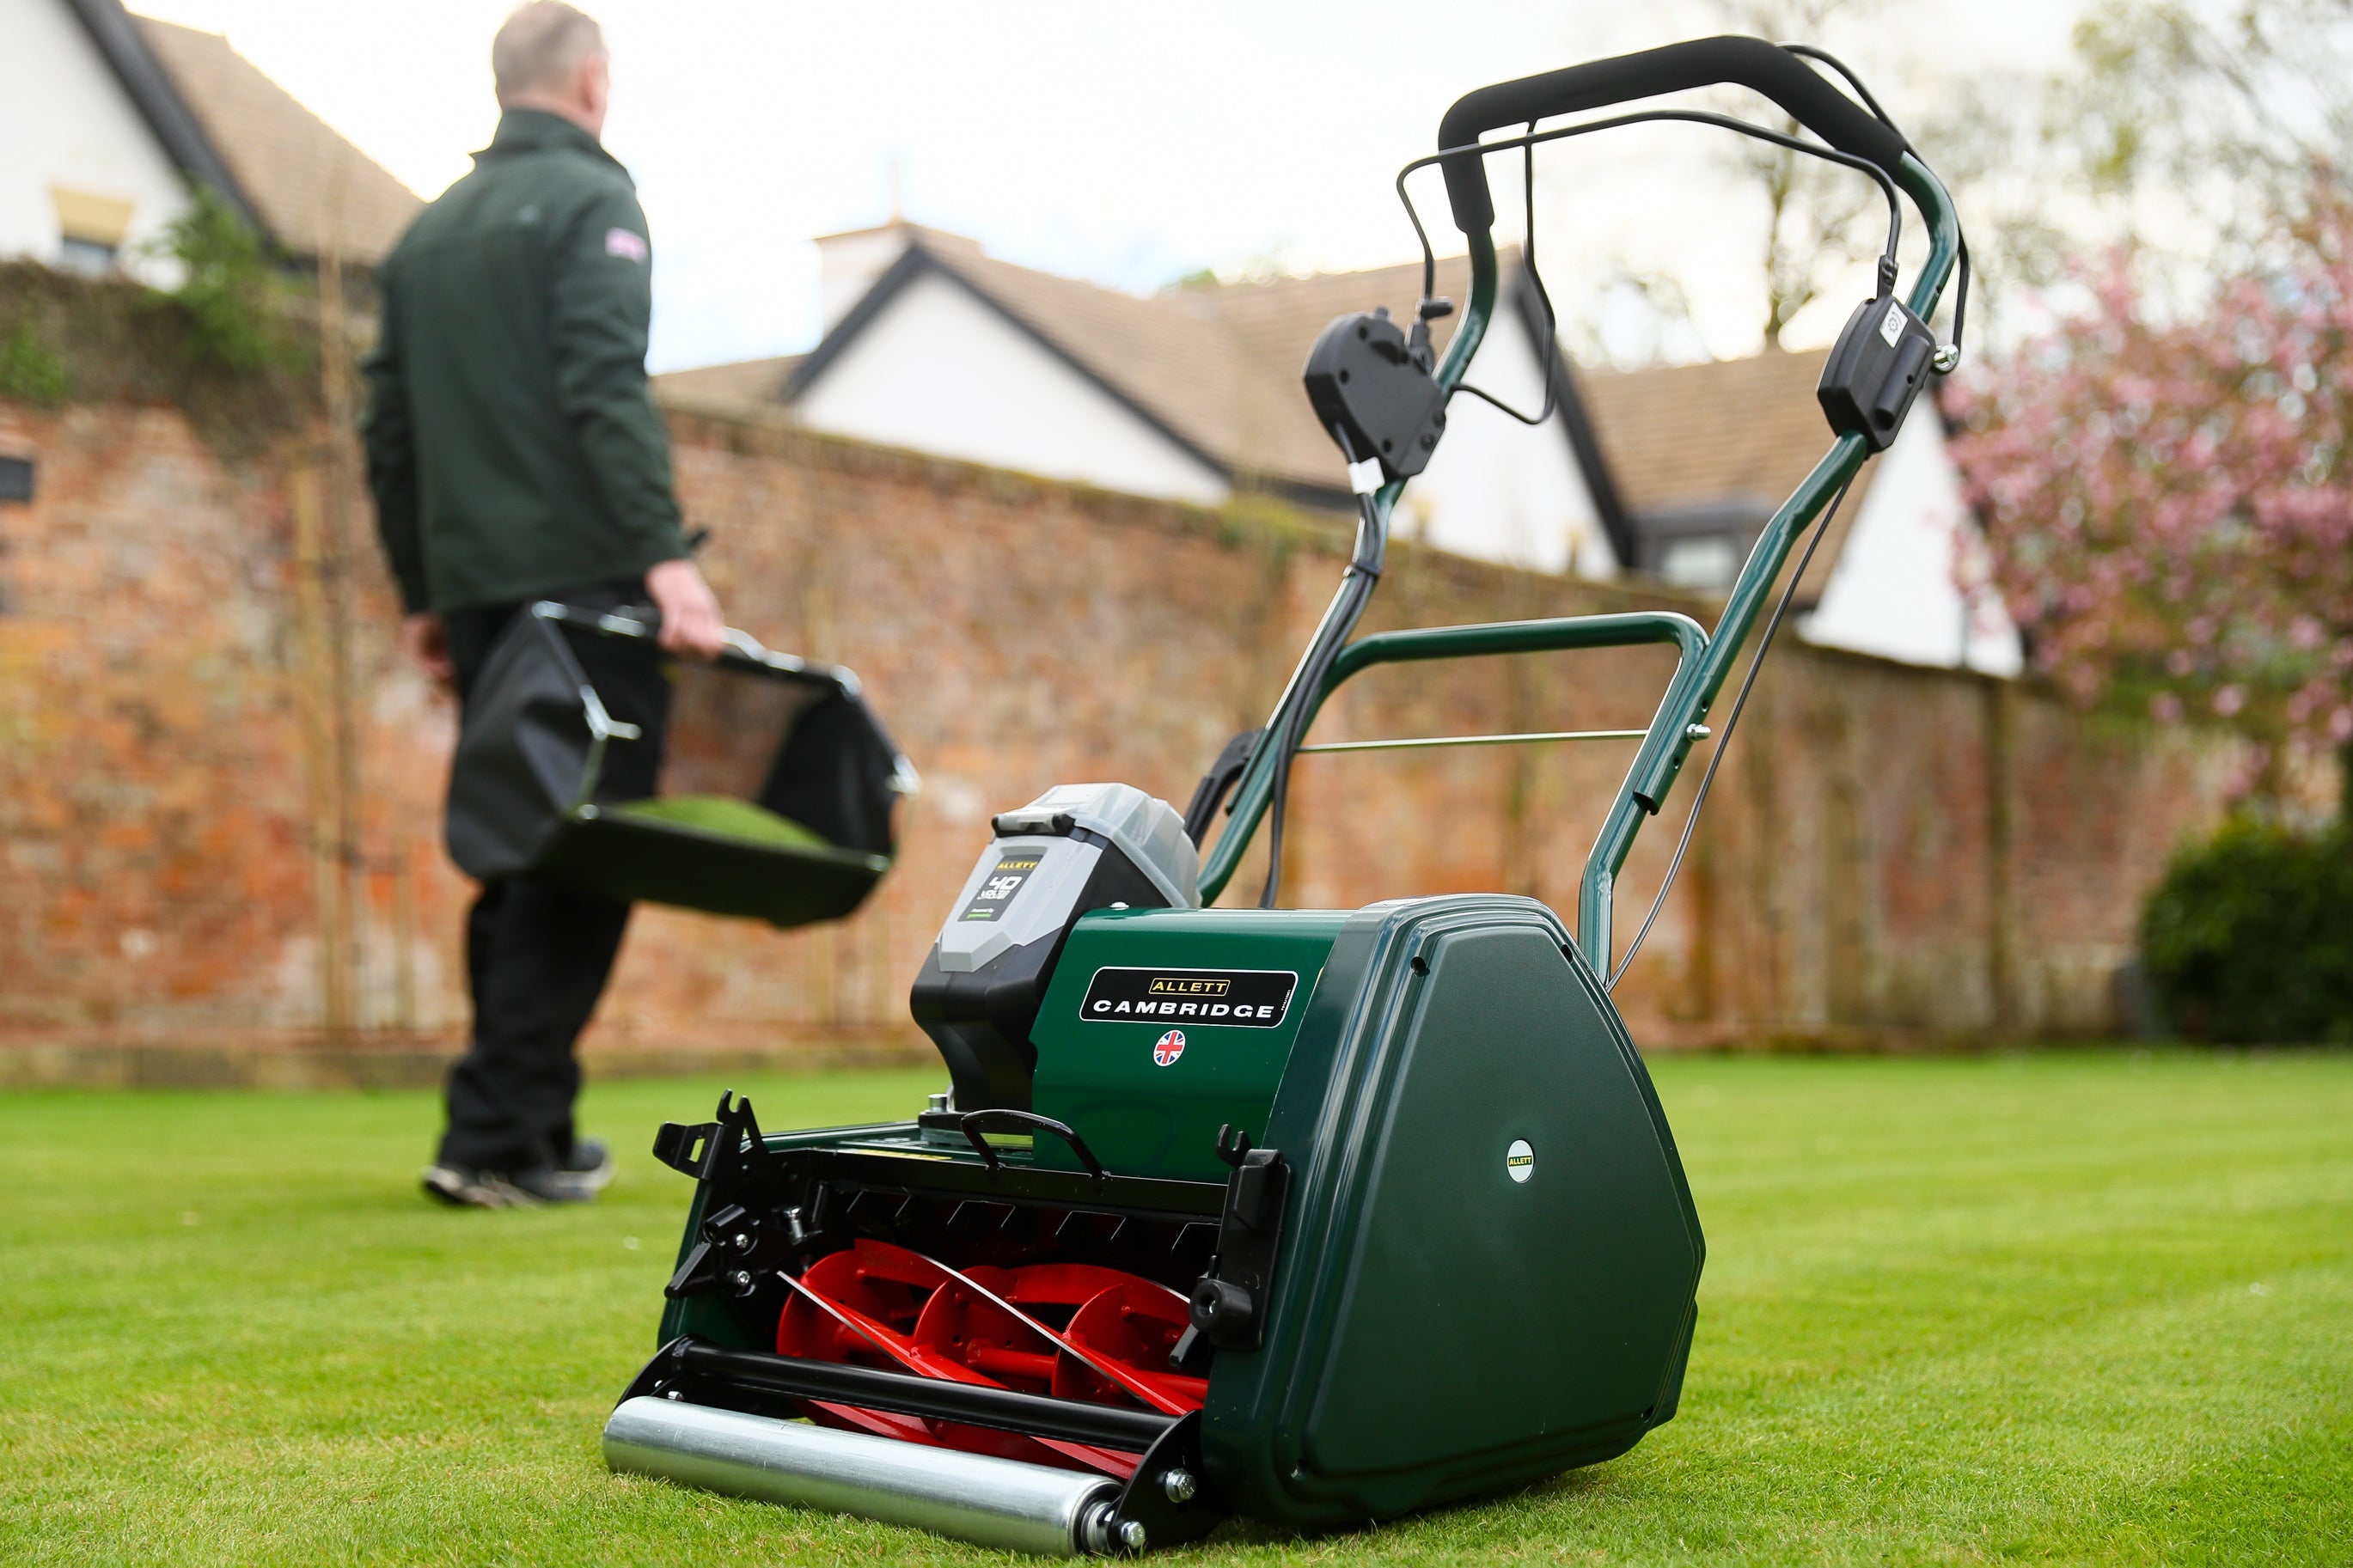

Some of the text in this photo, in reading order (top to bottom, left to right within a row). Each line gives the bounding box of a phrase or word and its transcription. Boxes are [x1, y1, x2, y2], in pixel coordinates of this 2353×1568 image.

[989, 876, 1023, 890] 40
[1152, 981, 1227, 992] ALLETT
[1092, 1000, 1274, 1018] CAMBRIDGE
